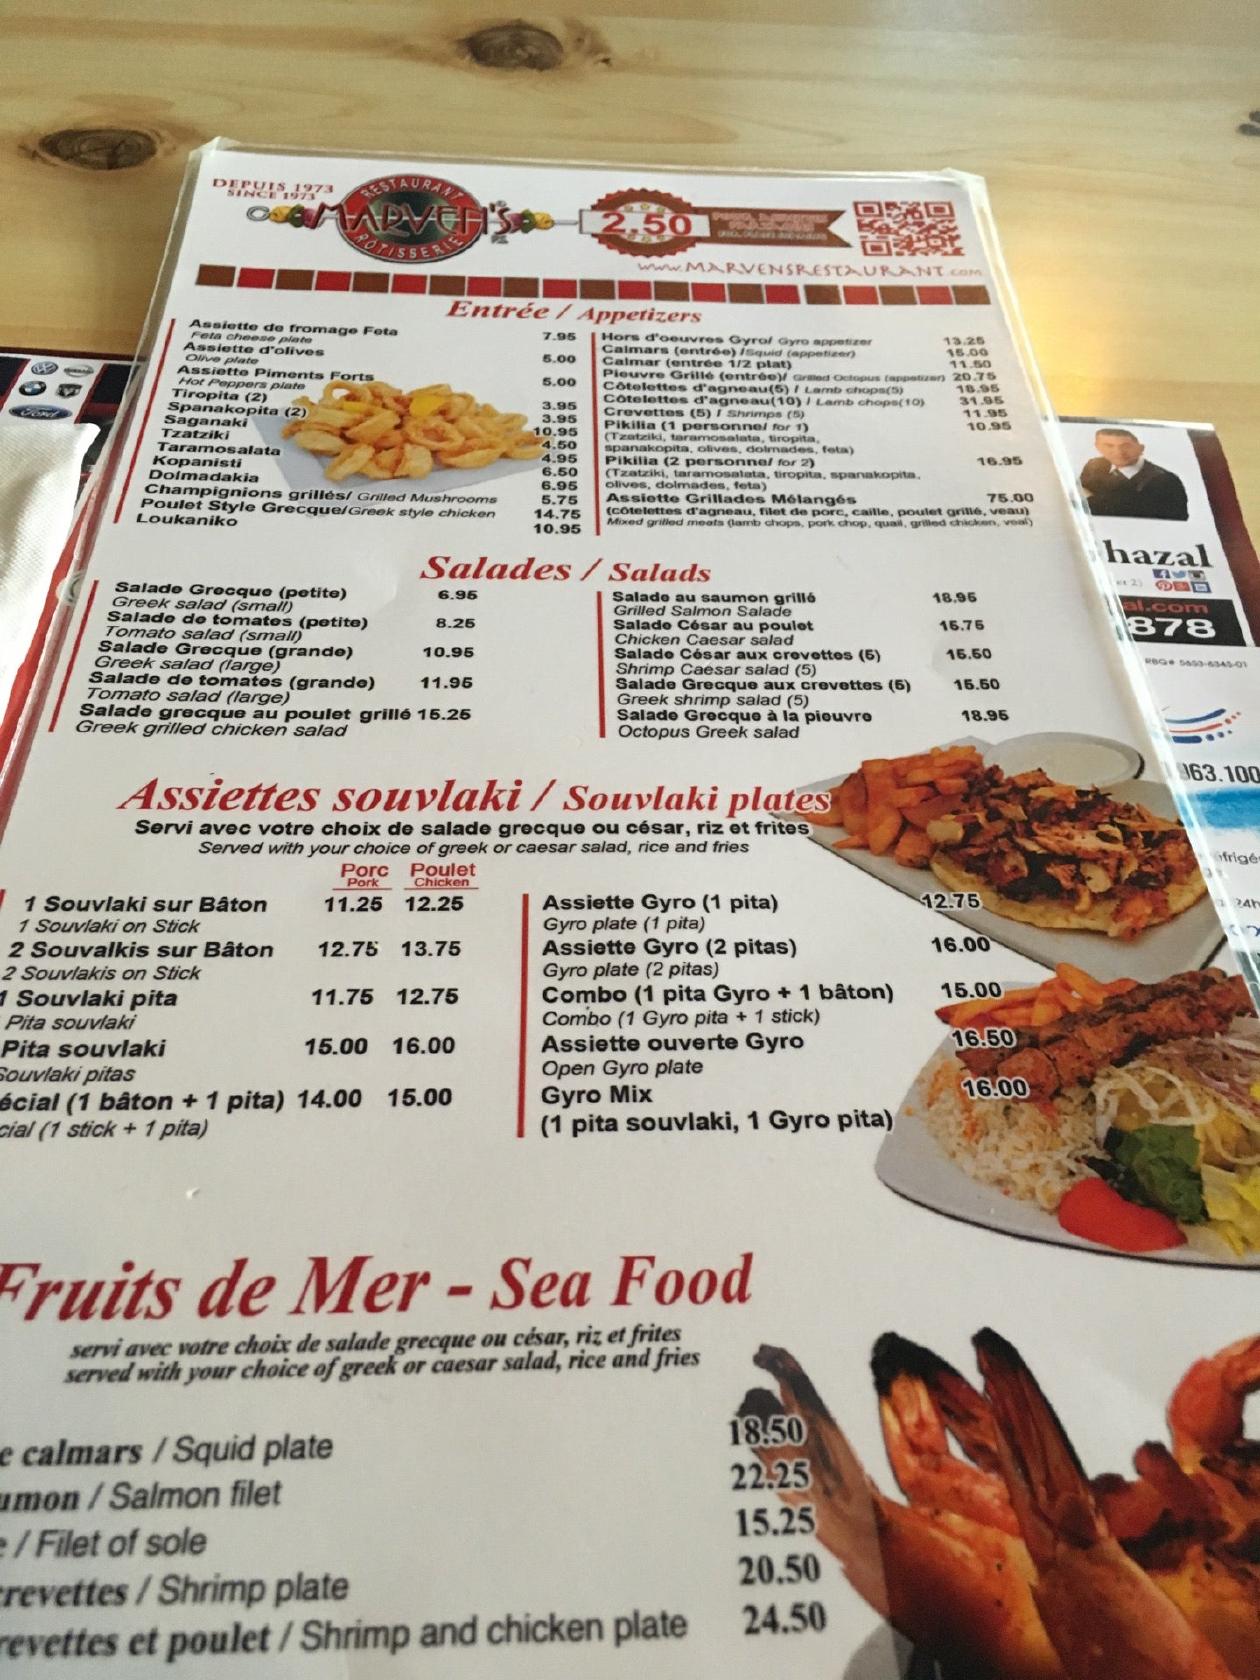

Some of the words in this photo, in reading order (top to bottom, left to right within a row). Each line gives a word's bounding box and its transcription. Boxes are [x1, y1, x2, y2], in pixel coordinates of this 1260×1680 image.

[212, 178, 285, 191] DEPUIS
[294, 184, 334, 192] 1973
[360, 178, 465, 200] RESTAURANT
[227, 190, 276, 199] SINCE
[283, 192, 315, 200] 1973
[602, 211, 692, 236] 2.50
[447, 301, 550, 319] Entrée
[578, 307, 701, 324] Appetizers
[189, 319, 258, 331] Assiette
[263, 324, 284, 332] de
[290, 324, 358, 336] fromage
[363, 326, 398, 336] Feta
[543, 332, 576, 341] 7.95
[184, 342, 254, 353] Assiette
[259, 346, 324, 356] d'olives
[543, 354, 576, 363] 5.00
[177, 365, 248, 376] Assiette
[255, 368, 324, 380] Piments
[330, 372, 374, 381] Forts
[543, 377, 576, 387] 5.00
[172, 388, 239, 402] Tiropita
[245, 393, 267, 403] (2)
[168, 402, 278, 416] Spanakopita
[285, 408, 306, 418] (2)
[543, 401, 577, 410] 3.95
[164, 415, 247, 427] Saganaki
[542, 414, 577, 423] 3.95
[162, 428, 229, 440] Tzatziki
[533, 426, 578, 437] 10.95
[158, 442, 280, 455] Taramosalata
[542, 440, 577, 450] 4.50
[153, 455, 241, 468] Kopanisti
[542, 454, 578, 463] 4.95
[149, 470, 259, 483] Dolmadakia
[542, 467, 578, 477] 6.50
[542, 481, 578, 491] 6.95
[606, 493, 679, 503] Assiette
[686, 494, 765, 504] Grillades
[772, 494, 856, 506] Mélangés
[137, 513, 237, 526] Loukaniko
[534, 524, 581, 534] 10.95
[420, 556, 571, 580] Salades
[608, 563, 711, 582] Salads
[115, 582, 182, 594] Salade
[189, 584, 272, 598] Grecque
[279, 587, 346, 601] (petite)
[438, 590, 477, 600] 6.95
[613, 591, 670, 602] Salade
[676, 594, 696, 602] au
[701, 594, 768, 603] saumon
[774, 592, 816, 606] grillé
[933, 592, 977, 603] 18.95
[614, 605, 666, 616] Grilled
[671, 605, 731, 616] Salmon
[737, 606, 792, 617] Salade
[436, 618, 475, 628] 8.25
[424, 647, 474, 658] 10.95
[421, 677, 472, 689] 11.95
[80, 703, 152, 717] Salade
[159, 708, 246, 722] grecque
[253, 710, 277, 719] au
[284, 708, 351, 723] poulet
[360, 709, 411, 724] grillé
[418, 709, 471, 720] 15.25
[617, 709, 678, 721] Salade
[684, 710, 761, 724] Grecque
[768, 710, 778, 721] à
[783, 710, 799, 722] la
[805, 710, 872, 725] pieuvre
[962, 710, 1009, 721] 18.95
[76, 720, 139, 733] Greek
[143, 722, 207, 737] grilled
[211, 724, 287, 736] chicken
[293, 725, 348, 737] salad
[619, 725, 690, 740] Octopus
[696, 725, 748, 738] Greek
[754, 726, 799, 738] salad
[116, 778, 320, 811] Assiettes
[332, 779, 522, 812] souvlaki
[563, 786, 718, 811] Souvlaki
[726, 786, 831, 818] plates
[341, 864, 389, 878] Porc
[410, 862, 476, 877] Poulet
[347, 878, 380, 887] Pork
[414, 878, 470, 887] Chicken
[25, 896, 36, 912] 1
[44, 896, 147, 912] Souvlaki
[153, 900, 193, 912] sur
[199, 896, 267, 912] Bâton
[325, 896, 382, 912] 11.25
[406, 896, 463, 912] 12.25
[543, 895, 634, 910] Assiette
[641, 894, 696, 913] Gyro
[703, 894, 720, 913] (1
[730, 894, 778, 913] pita)
[921, 893, 980, 909] 12.75
[8, 942, 24, 958] 2
[31, 941, 149, 958] Souvalkis
[157, 946, 198, 958] sur
[204, 941, 273, 957] Bâton
[319, 941, 378, 957] 12.75
[402, 941, 461, 956] 13.75
[952, 1029, 1014, 1047] 16.50
[542, 1060, 595, 1080] Open
[603, 1060, 649, 1079] Gyro
[655, 1059, 703, 1078] plate
[963, 1078, 1027, 1097] 16.00
[542, 1086, 601, 1109] Gyro
[610, 1085, 653, 1103] Mix
[0, 1261, 182, 1321] Fruits
[198, 1258, 276, 1318] de
[289, 1256, 431, 1315] Mer
[490, 1258, 591, 1310] Sea
[611, 1252, 753, 1306] Food
[729, 1417, 803, 1445] 18.50
[21, 1439, 142, 1466] calmars
[173, 1434, 256, 1467] Squid
[263, 1434, 333, 1466] plate
[731, 1461, 809, 1490] 22.25
[109, 1481, 220, 1510] Salmon
[230, 1480, 282, 1507] filet
[737, 1506, 815, 1537] 15.25
[35, 1529, 101, 1558] Filet
[108, 1528, 140, 1558] of
[145, 1527, 207, 1557] sole
[738, 1553, 820, 1585] 20.50
[158, 1574, 266, 1609] Shrimp
[274, 1572, 349, 1608] plate
[743, 1601, 826, 1635] 24.50
[128, 1628, 158, 1656] et
[167, 1622, 271, 1662] poulet
[300, 1620, 410, 1655] Shrimp
[419, 1615, 478, 1648] and
[487, 1613, 604, 1645] chicken
[614, 1609, 688, 1648] plate
